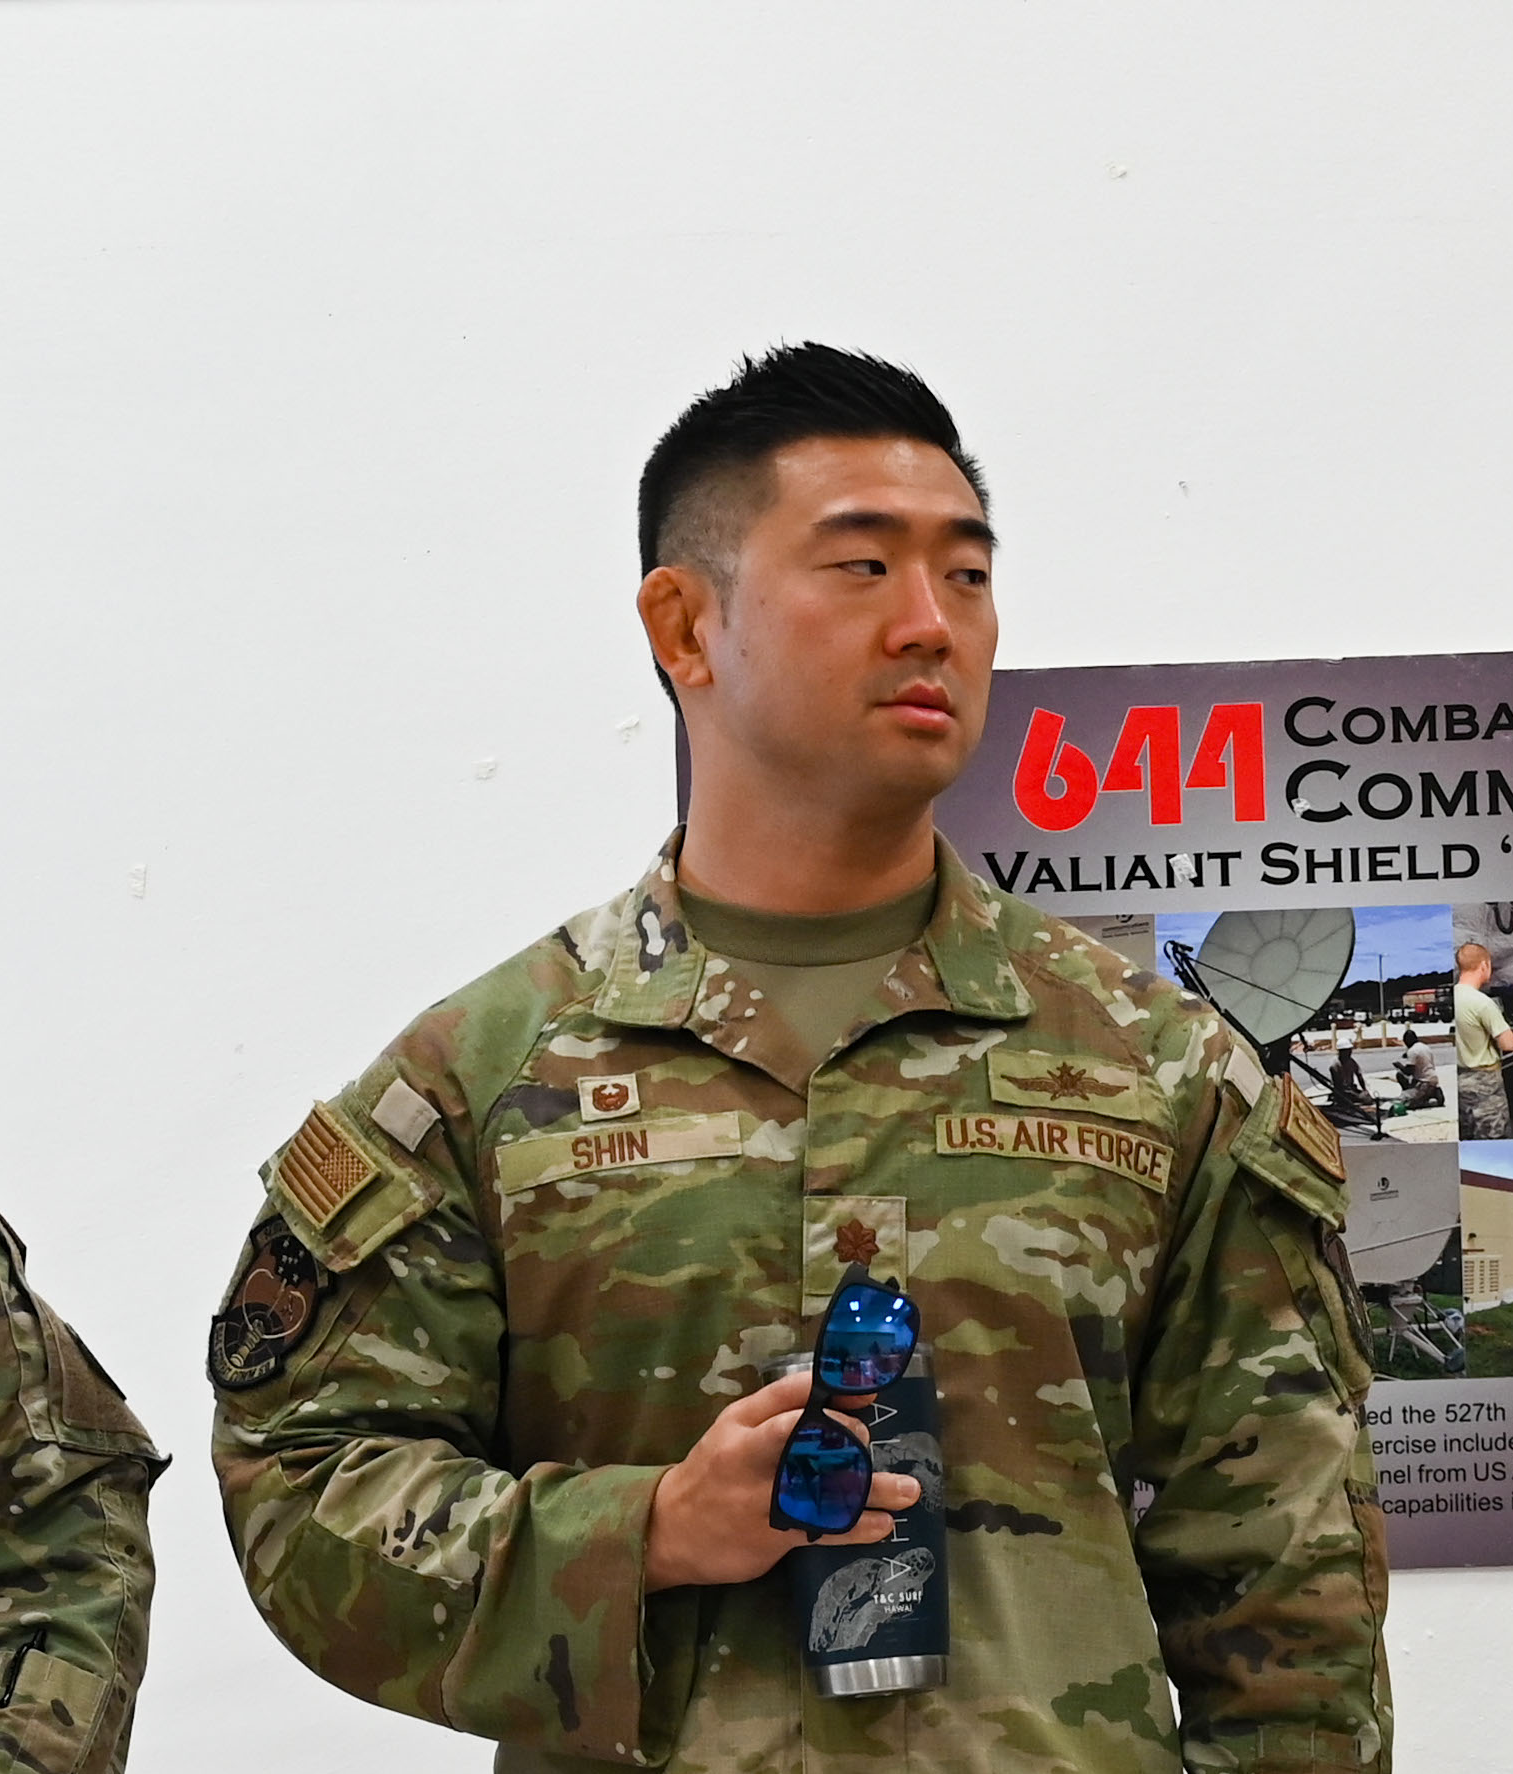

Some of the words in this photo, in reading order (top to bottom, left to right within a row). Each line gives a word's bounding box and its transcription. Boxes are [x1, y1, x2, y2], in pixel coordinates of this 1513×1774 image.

[1012, 702, 1266, 832] 644
[982, 850, 1241, 894] VALIANT
[1260, 842, 1480, 885] SHIELD
[572, 1129, 649, 1170] SHIN
[944, 1119, 1003, 1152] U.S.
[1013, 1123, 1068, 1157] AIR
[1078, 1125, 1168, 1185] FORCE
[1402, 1405, 1436, 1424] the
[1445, 1402, 1506, 1423] 527th
[1371, 1433, 1436, 1455] ercise
[869, 1402, 912, 1583] ALHA
[1418, 1463, 1467, 1484] from
[1473, 1461, 1506, 1482] US
[1381, 1491, 1504, 1518] capabilities
